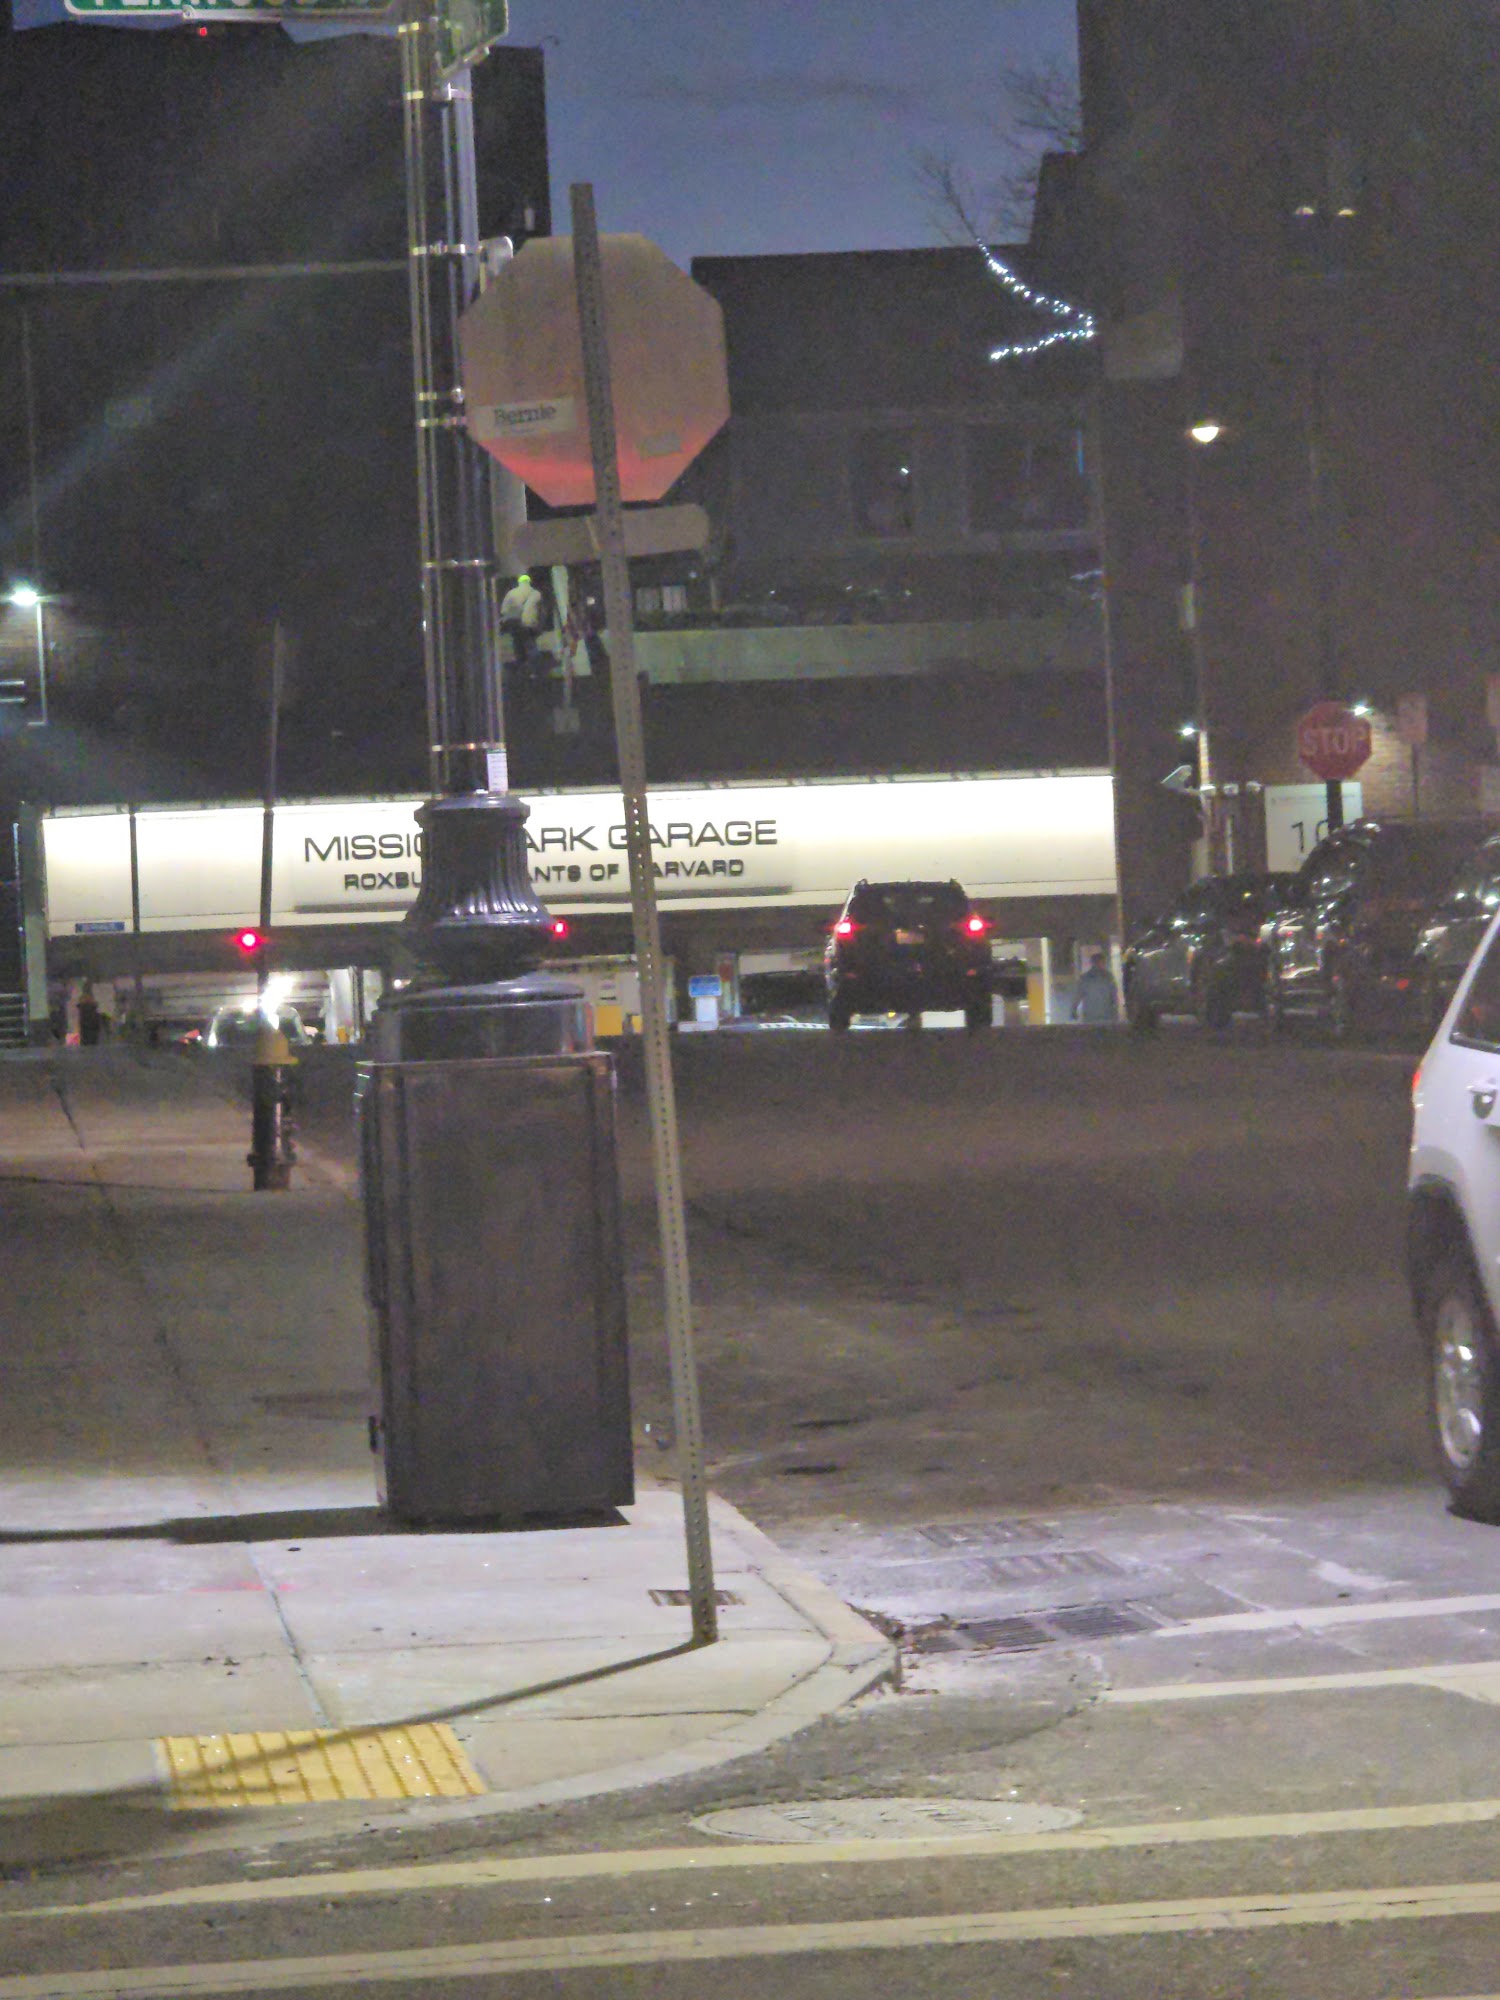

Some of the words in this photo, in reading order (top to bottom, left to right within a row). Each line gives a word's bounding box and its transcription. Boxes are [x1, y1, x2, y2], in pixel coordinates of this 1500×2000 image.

[1303, 727, 1367, 756] STOP
[304, 833, 422, 862] MISSI
[525, 825, 599, 852] ARK
[608, 819, 778, 850] GARAGE
[344, 871, 422, 890] ROXBU
[589, 863, 619, 882] OF
[651, 859, 744, 878] ARVARD
